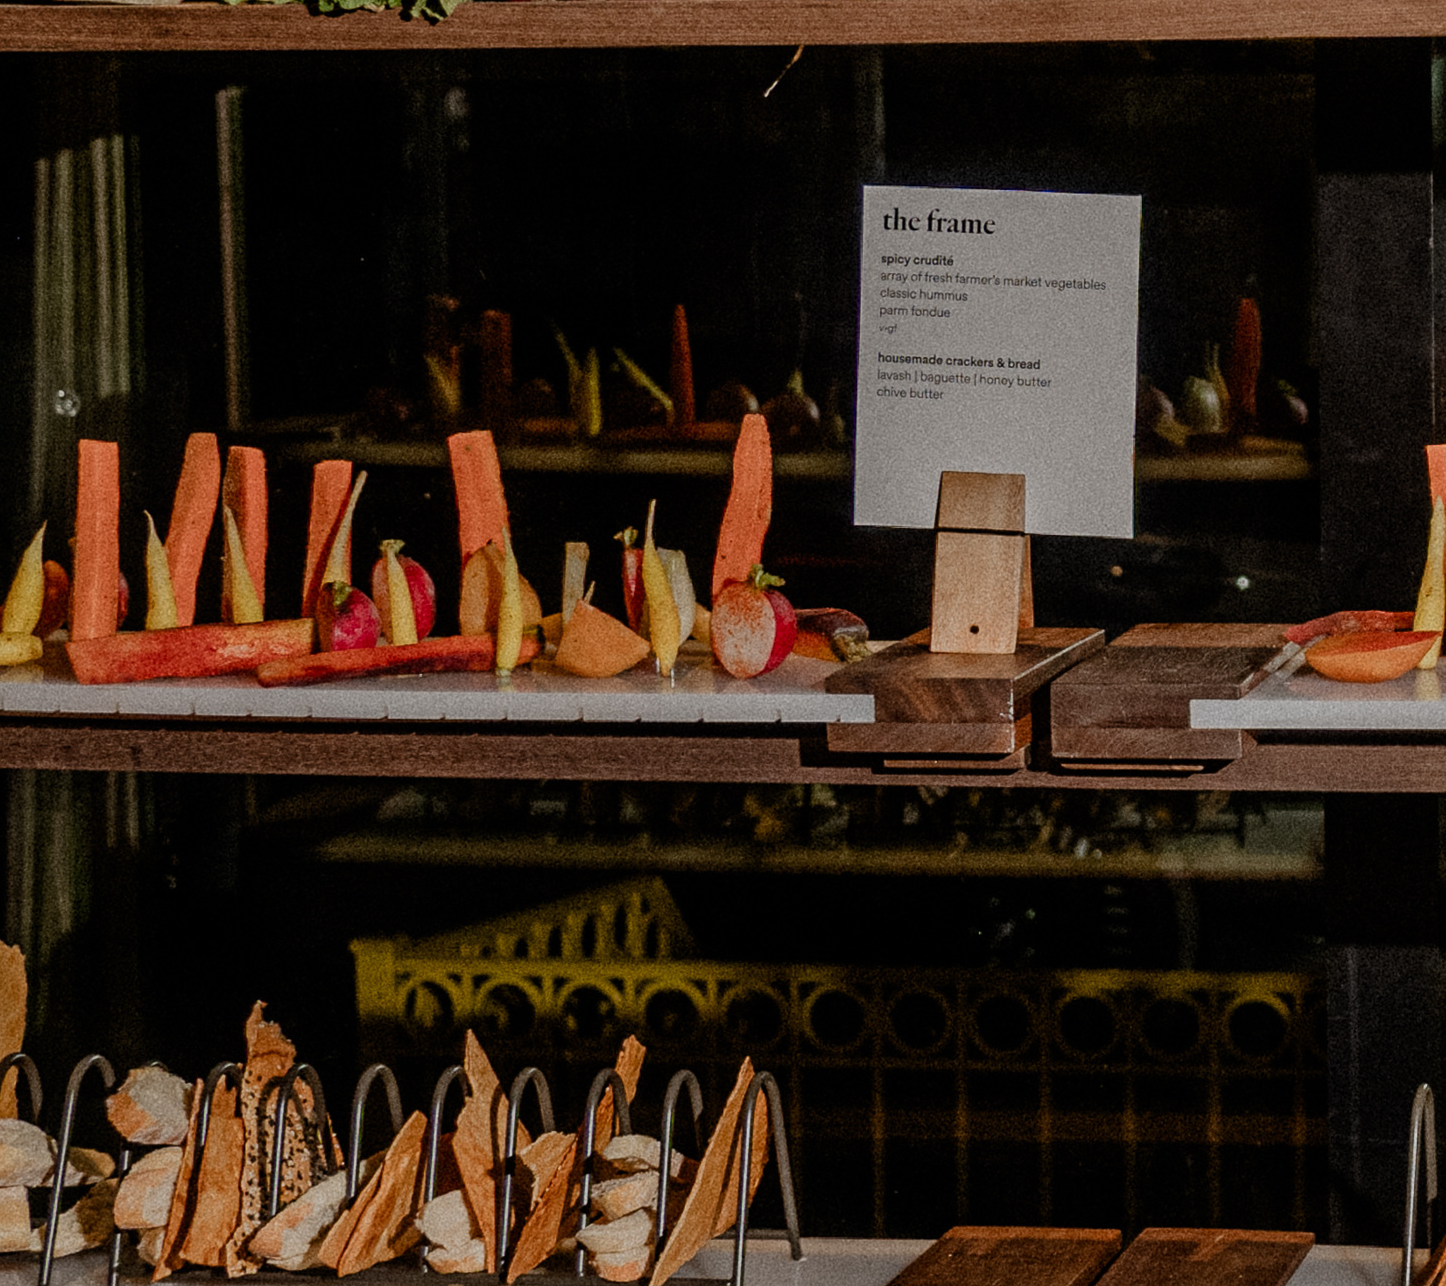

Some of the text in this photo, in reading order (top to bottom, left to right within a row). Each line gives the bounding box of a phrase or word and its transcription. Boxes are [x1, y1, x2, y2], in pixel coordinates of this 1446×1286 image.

[883, 207, 996, 235] the frame
[881, 254, 954, 267] spicy crudité
[880, 272, 908, 284] array
[911, 272, 924, 283] of
[925, 272, 953, 284] fresh
[1003, 275, 1042, 288] market
[1044, 278, 1106, 292] vegetables
[880, 288, 969, 302] classic hummus
[879, 305, 951, 318] parm fondue
[878, 352, 1041, 370] housemade crackers & bread
[877, 369, 912, 381] lavash
[920, 371, 971, 386] baguette
[979, 374, 1014, 389] honey
[1017, 375, 1052, 388] butter
[876, 386, 944, 400] chive butter
